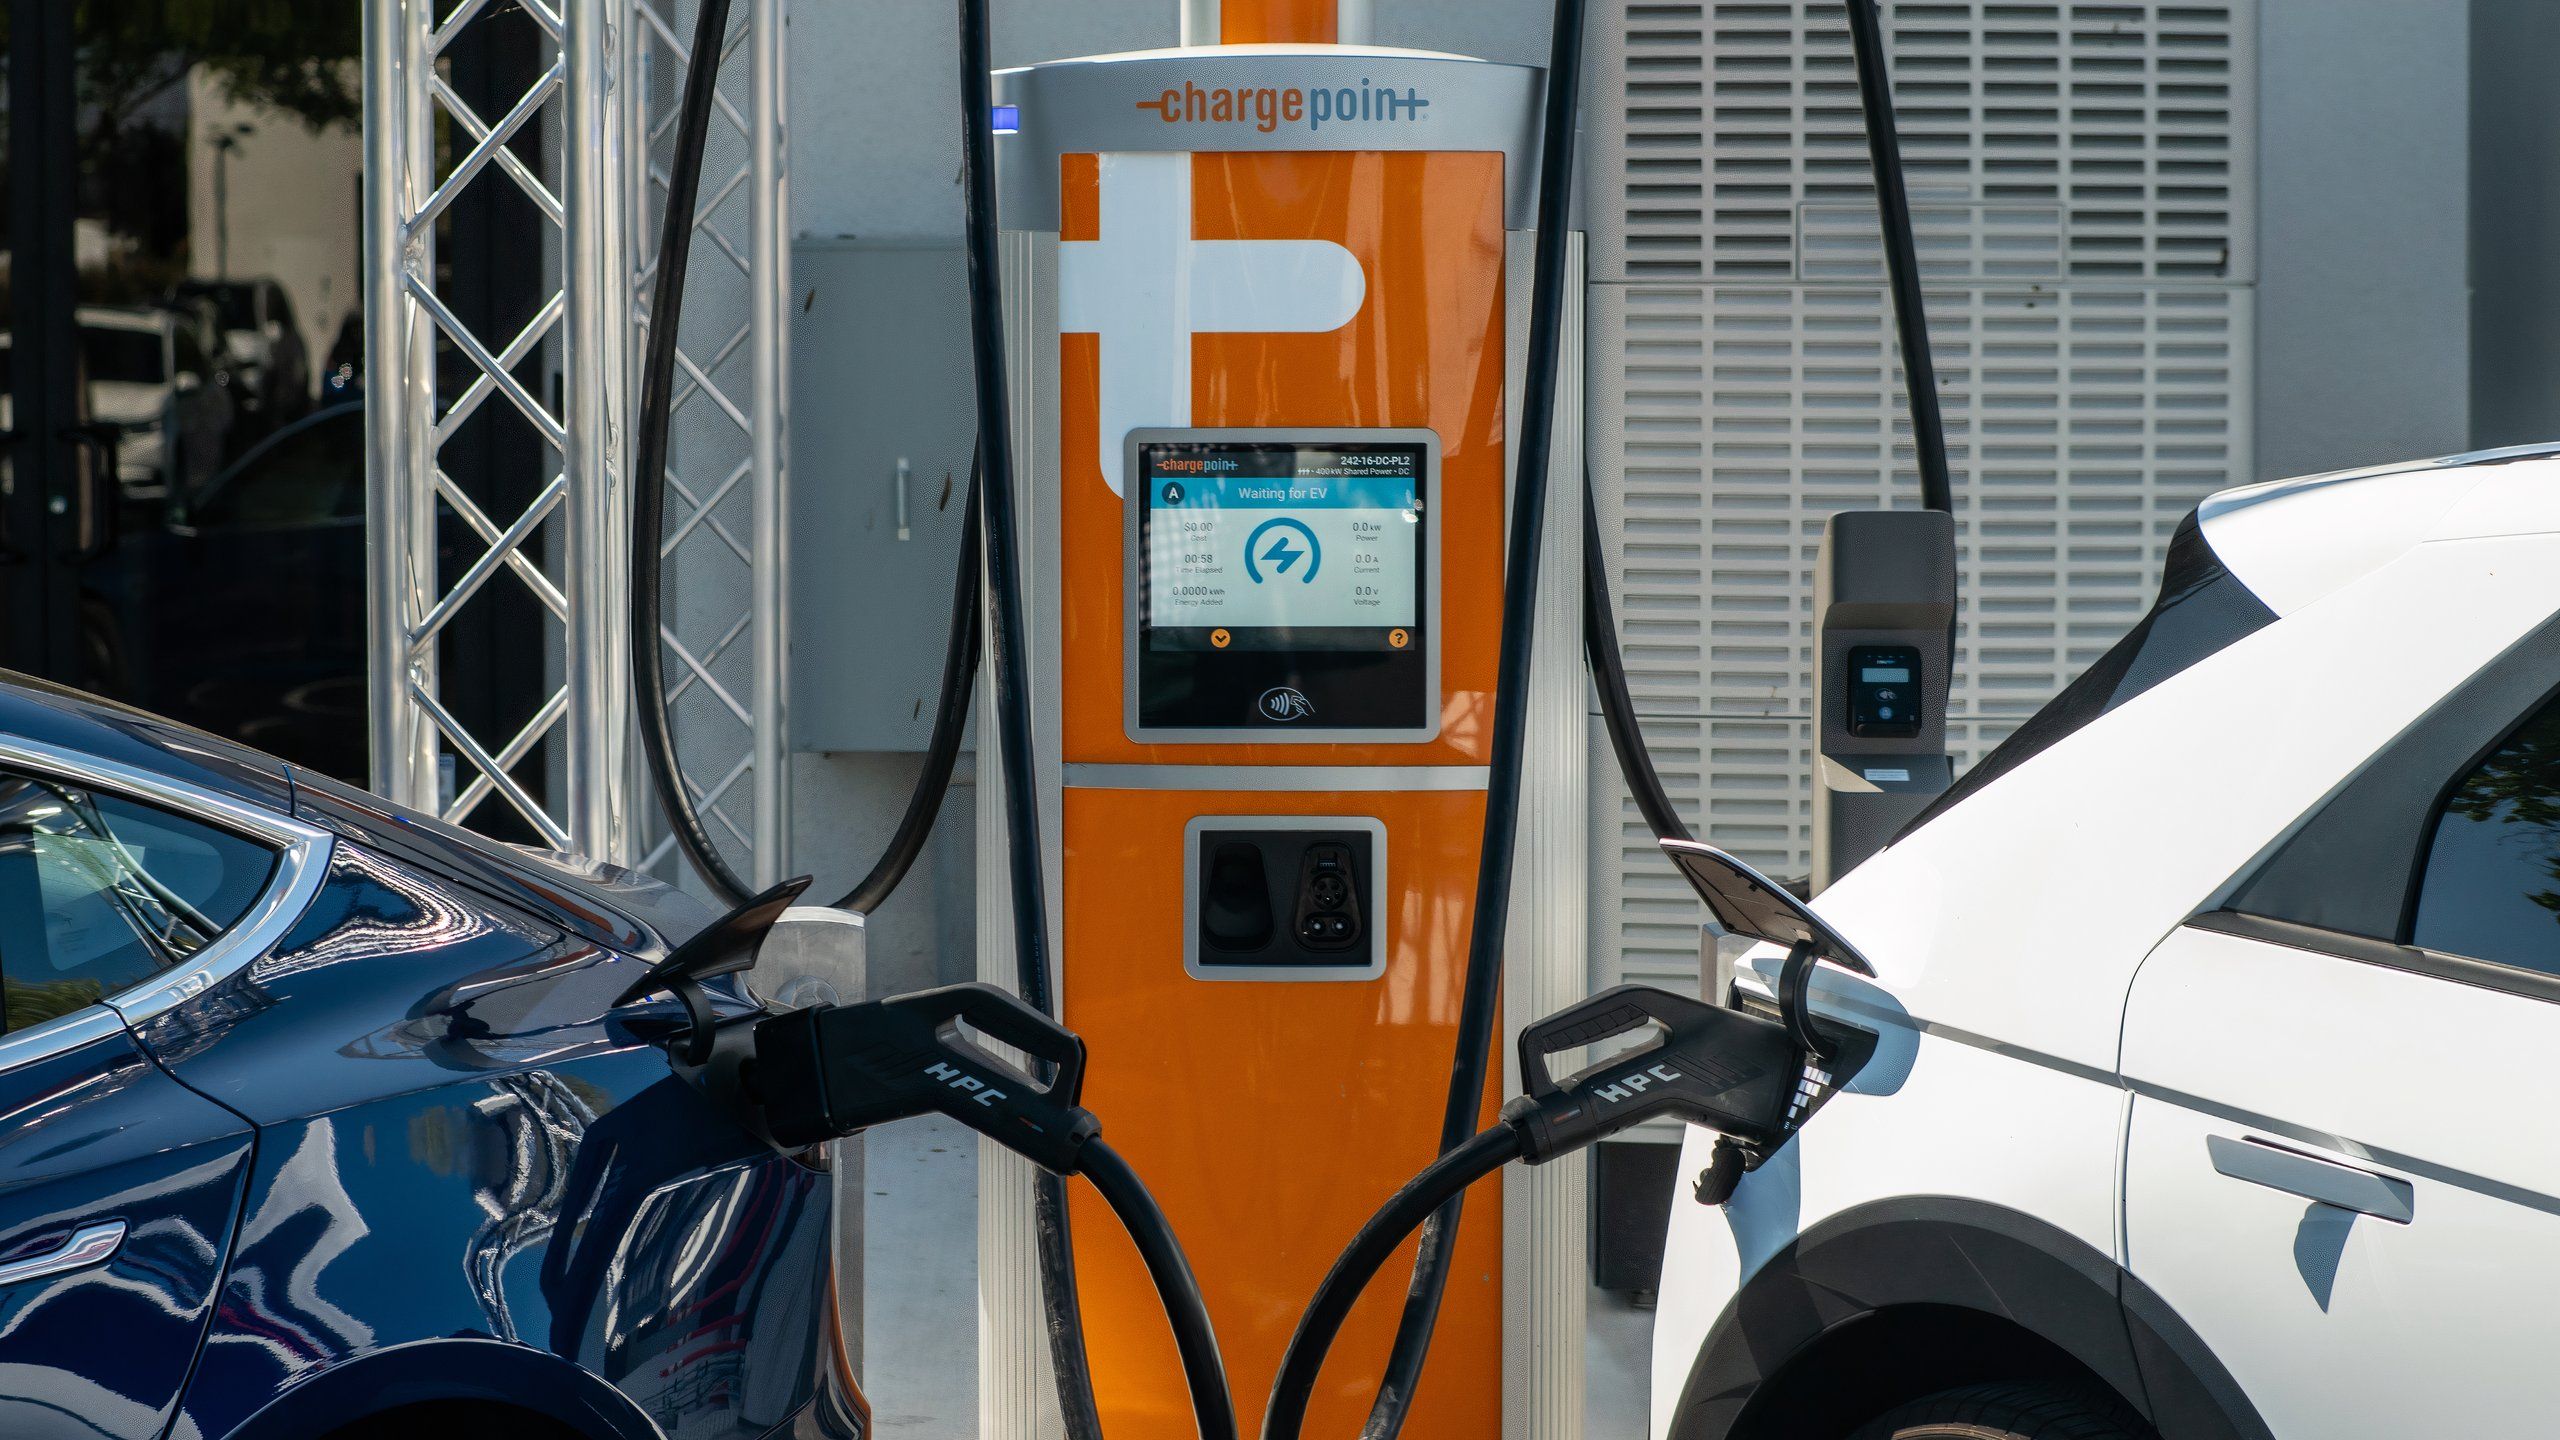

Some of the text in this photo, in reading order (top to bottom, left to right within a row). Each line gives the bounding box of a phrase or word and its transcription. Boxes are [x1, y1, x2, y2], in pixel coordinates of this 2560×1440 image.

[1340, 456, 1410, 466] 242-16-DC-PL2
[1343, 467, 1368, 476] Shared
[1370, 467, 1392, 475] Power
[1168, 487, 1179, 499] A
[1238, 487, 1328, 502] Waiting for EV
[1352, 522, 1369, 532] 0.0
[1190, 534, 1207, 542] Cost
[1355, 534, 1378, 542] Power
[1184, 554, 1214, 564] 00:58
[1355, 554, 1371, 564] 0.0
[1195, 566, 1223, 575] Elapsed
[1353, 566, 1380, 574] Current
[1172, 586, 1208, 596] 0.0000
[1355, 586, 1371, 596] 0.0
[1175, 598, 1223, 607] Energy Added
[1353, 598, 1381, 607] Voltage
[923, 1061, 1007, 1107] HPC
[1594, 1064, 1682, 1103] HPC
